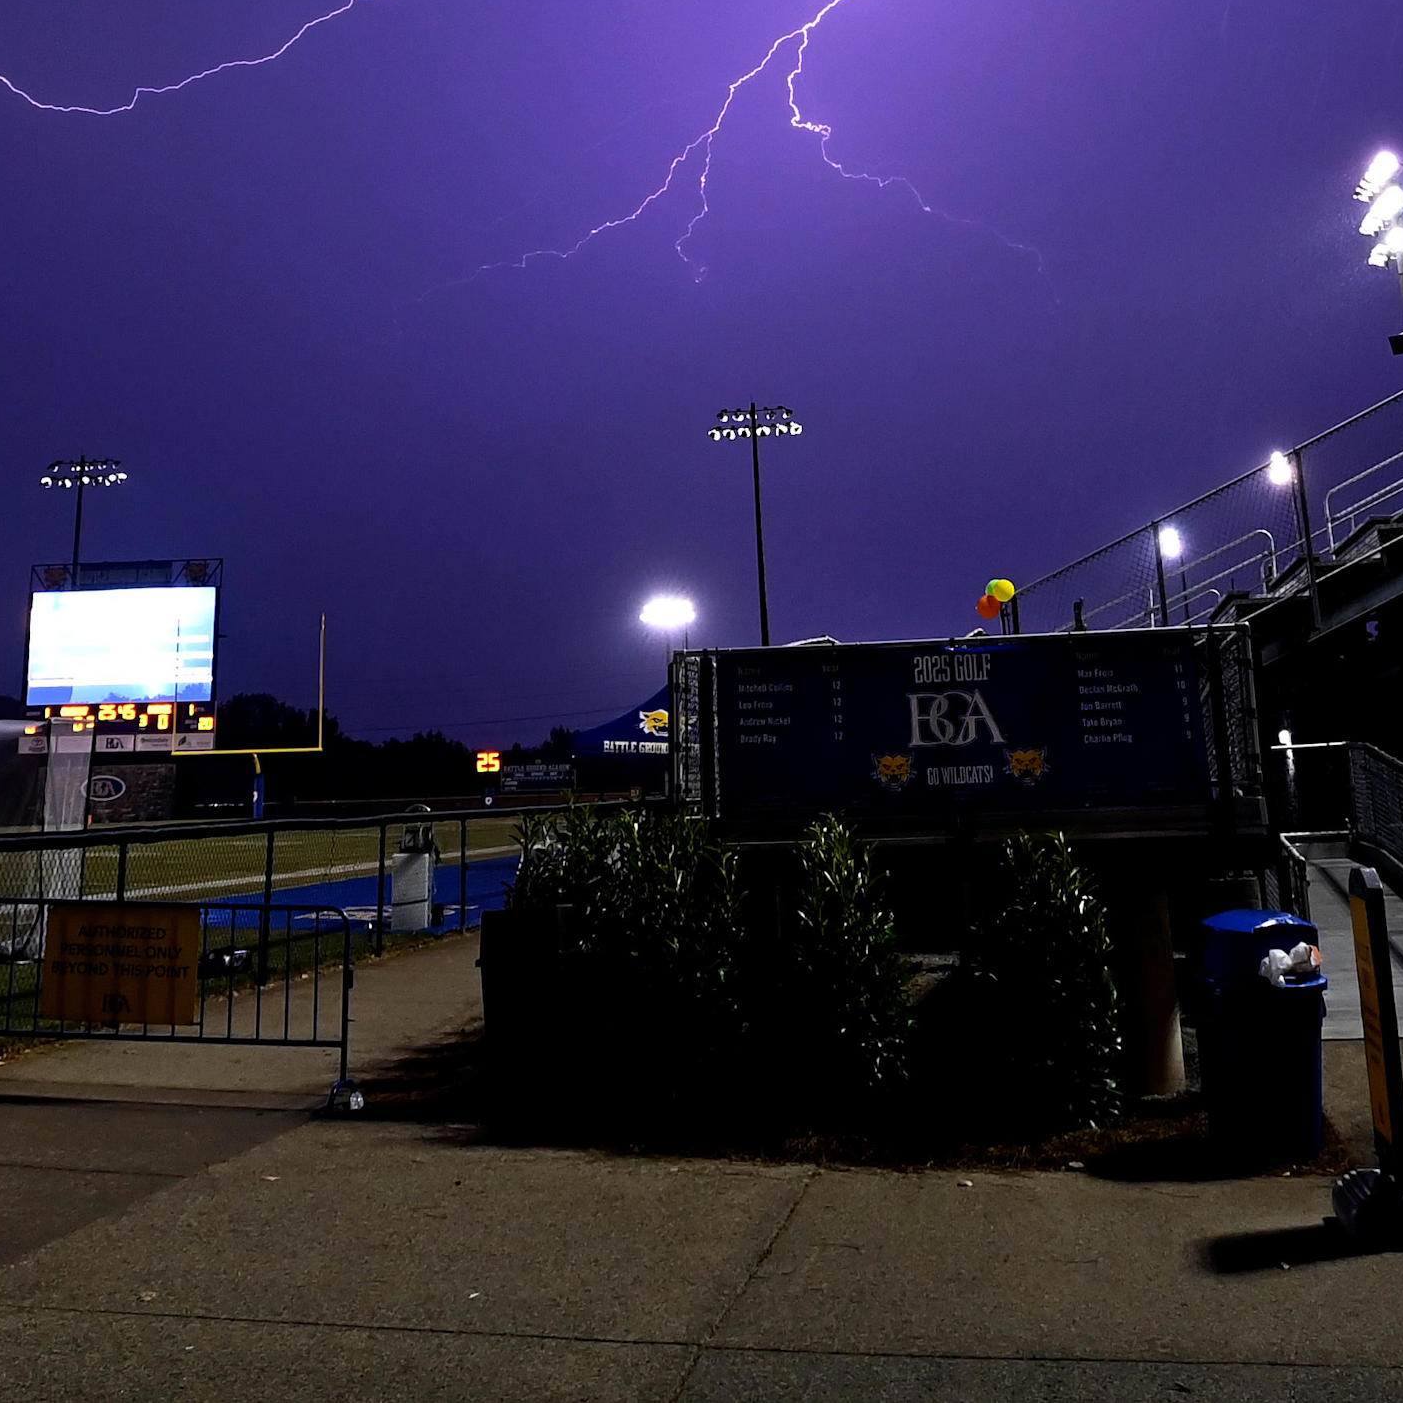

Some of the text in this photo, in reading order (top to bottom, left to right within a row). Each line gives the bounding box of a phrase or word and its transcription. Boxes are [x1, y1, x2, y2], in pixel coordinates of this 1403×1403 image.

[913, 653, 991, 684] 2025 GOLF
[832, 680, 841, 690] 12
[833, 697, 842, 707] 12
[834, 714, 843, 724] 12
[906, 688, 1007, 748] BGA
[834, 731, 844, 740] 12
[603, 740, 637, 753] BATTLE
[476, 752, 500, 773] 25
[926, 764, 994, 786] GO WILDCATS!
[78, 925, 167, 940] AUTHORIZED
[60, 942, 182, 960] PERSONNEL ONLY
[51, 961, 190, 979] BEYOND THIS POINT
